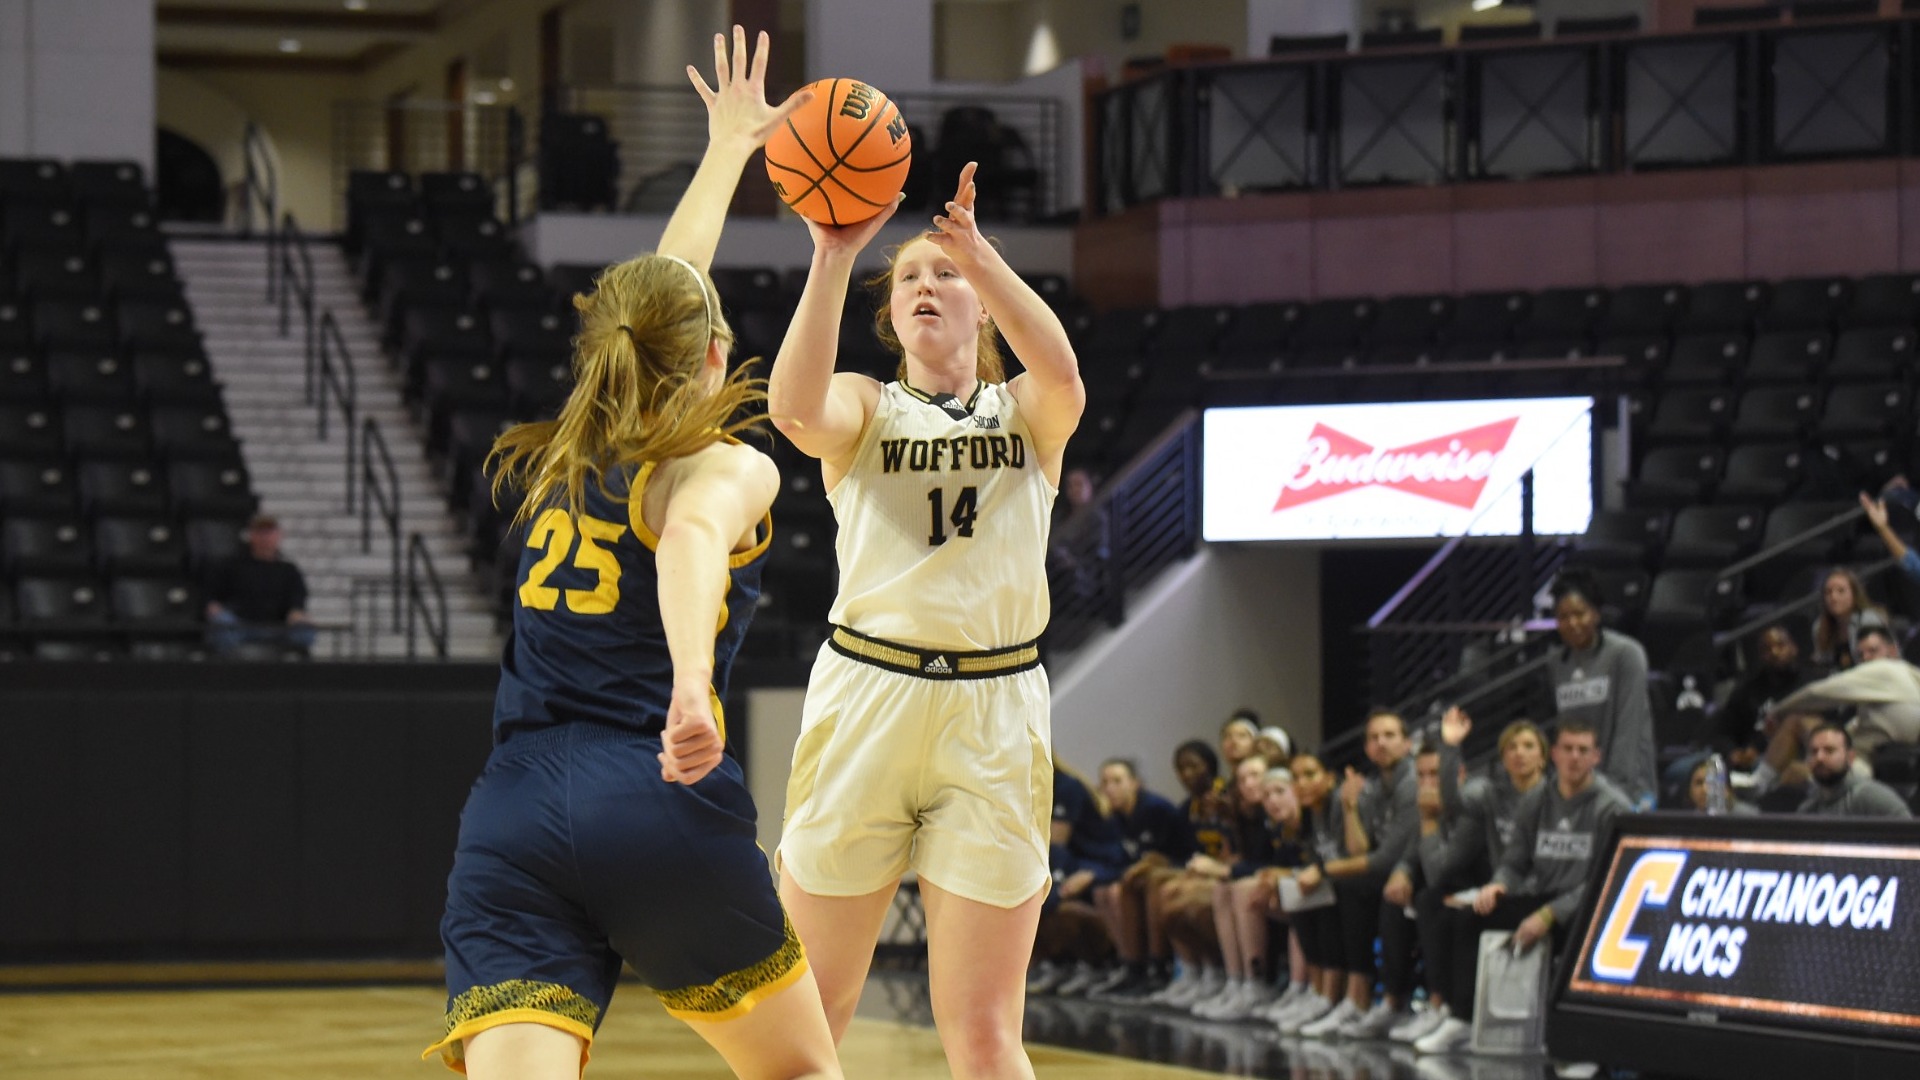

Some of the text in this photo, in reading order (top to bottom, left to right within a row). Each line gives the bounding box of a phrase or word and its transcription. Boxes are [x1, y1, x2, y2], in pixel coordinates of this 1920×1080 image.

[880, 433, 1026, 473] WOFFORD
[927, 486, 978, 546] 14
[518, 508, 628, 615] 25
[924, 665, 953, 674] adidas
[1680, 865, 1899, 930] CHATTANOOGA
[1658, 921, 1748, 978] MOCS
